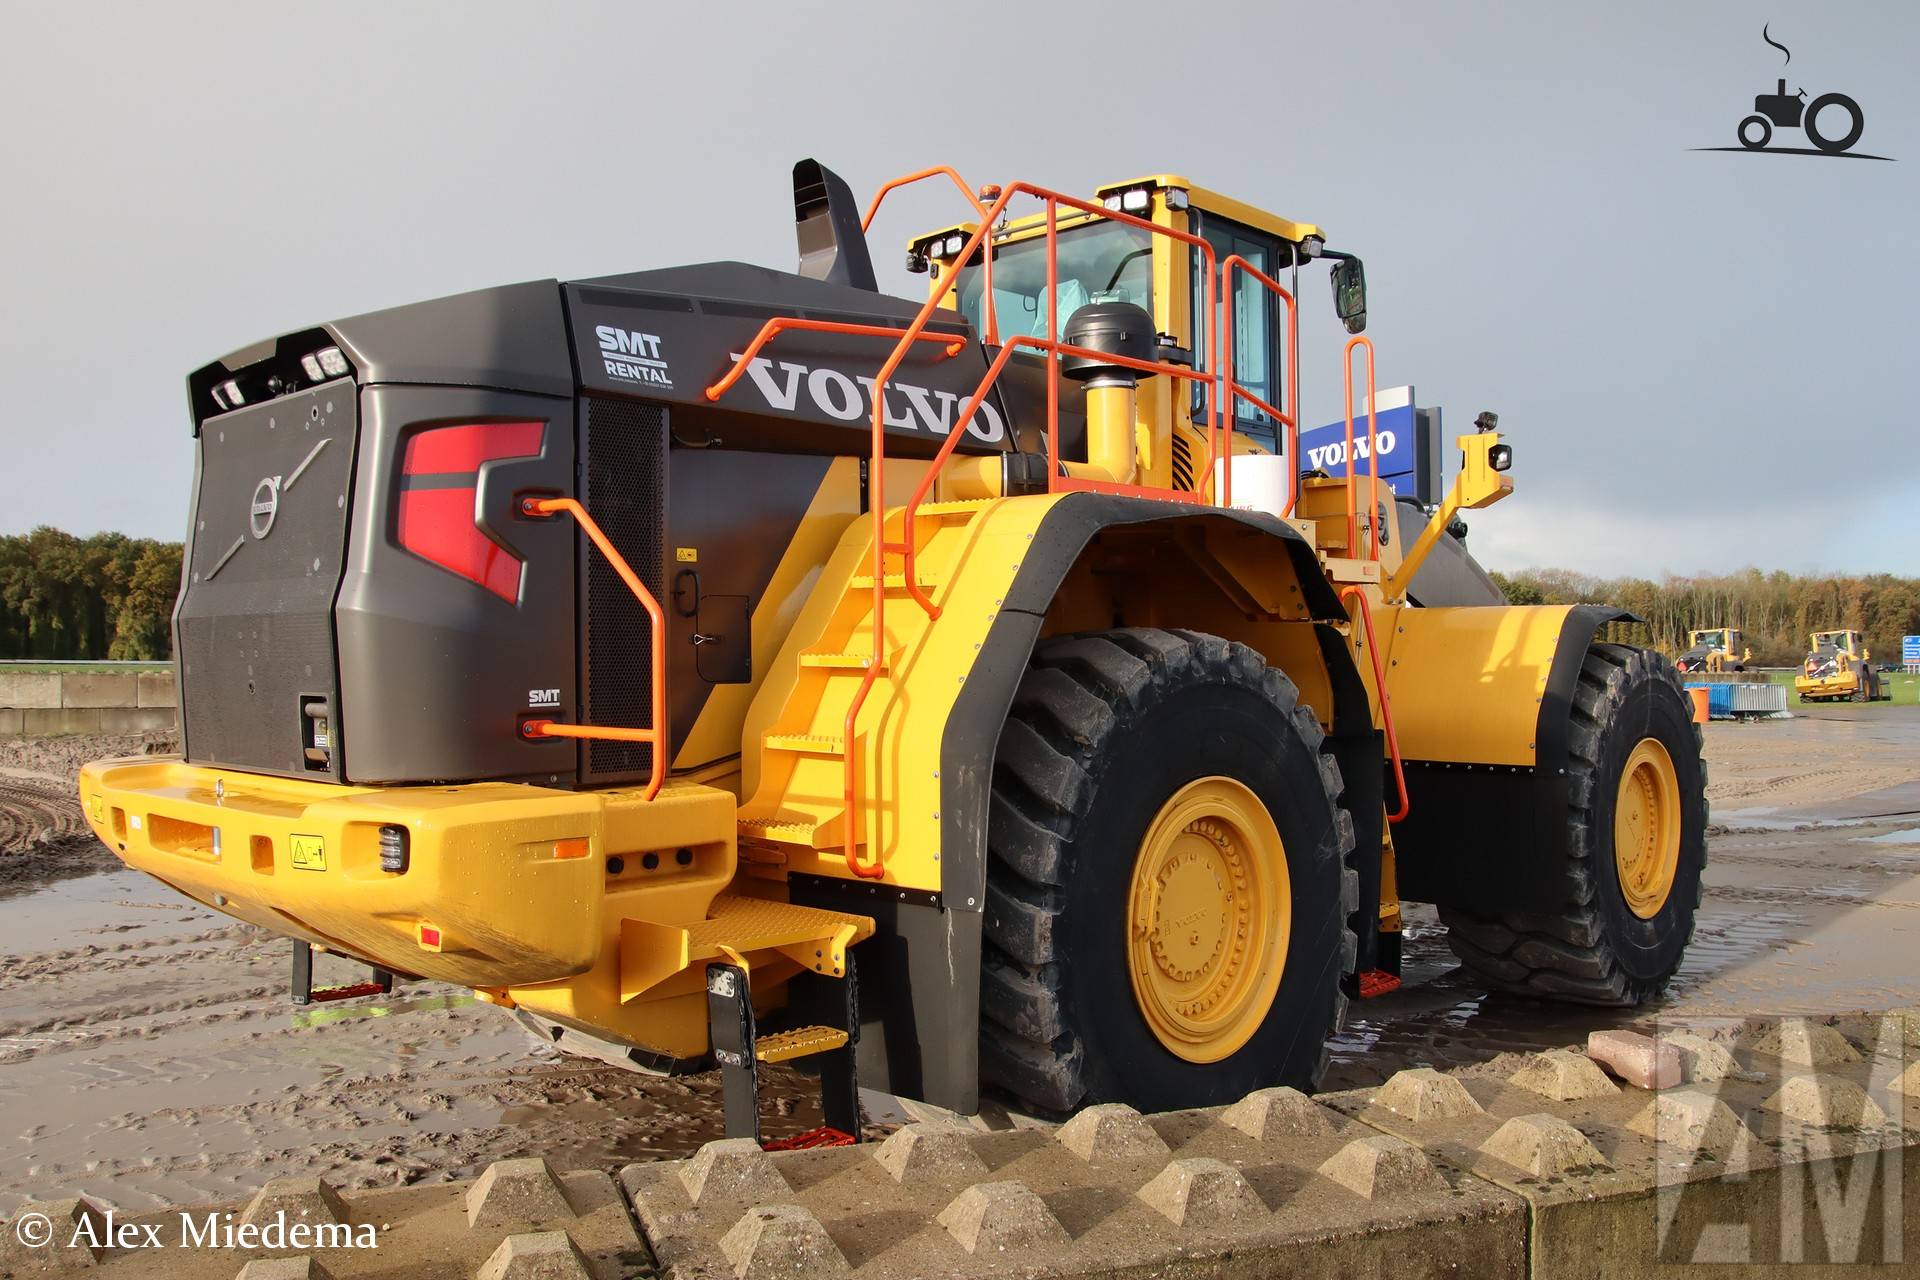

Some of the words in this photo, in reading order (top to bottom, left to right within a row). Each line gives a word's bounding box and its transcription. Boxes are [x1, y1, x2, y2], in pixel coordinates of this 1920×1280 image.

[595, 325, 661, 359] SMT
[604, 360, 673, 385] RENTAL
[730, 352, 1004, 443] VOLVO
[1308, 430, 1396, 470] VOLVO
[528, 688, 560, 703] SMT
